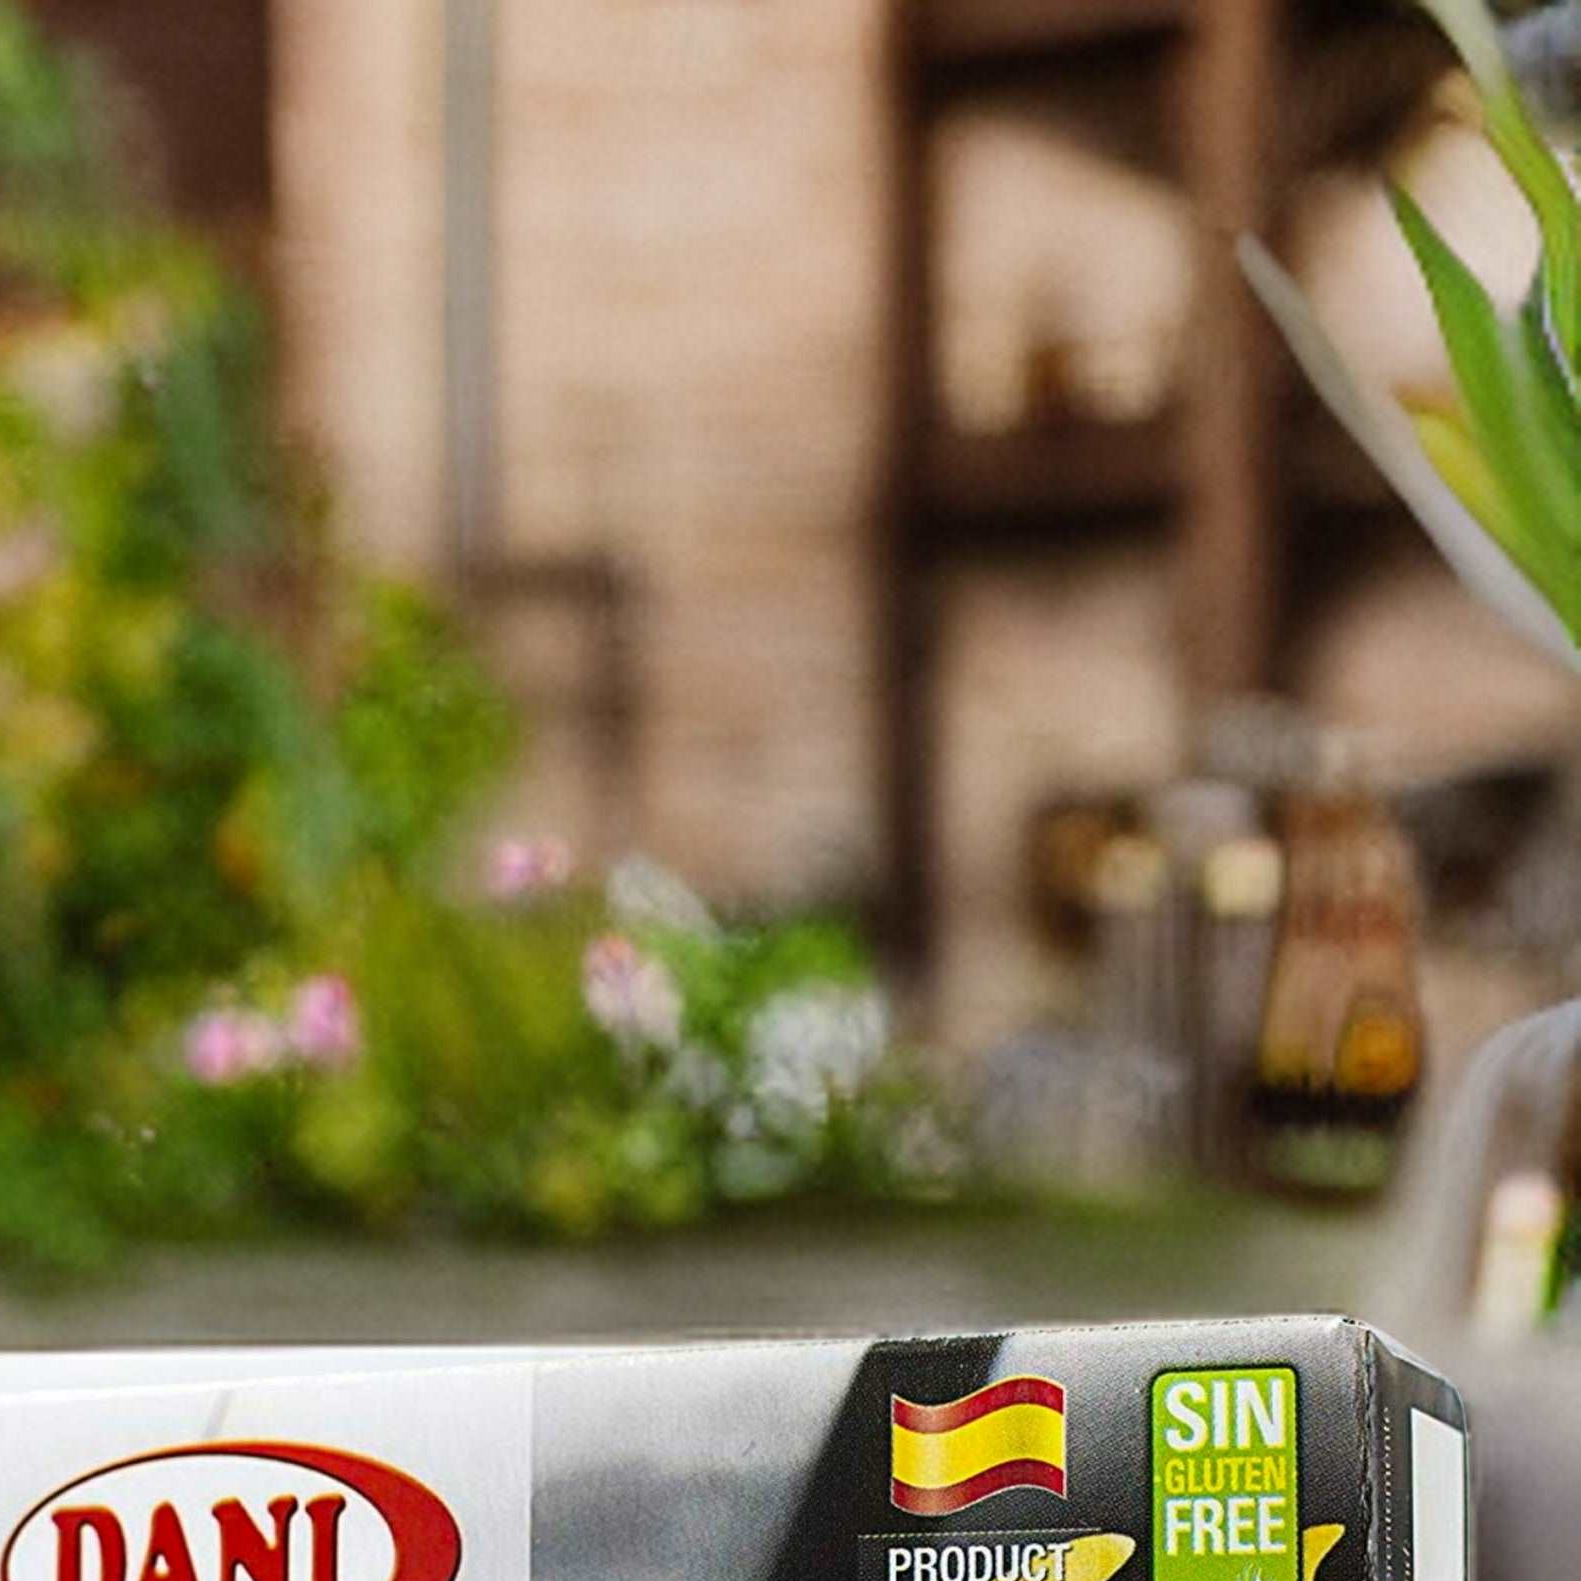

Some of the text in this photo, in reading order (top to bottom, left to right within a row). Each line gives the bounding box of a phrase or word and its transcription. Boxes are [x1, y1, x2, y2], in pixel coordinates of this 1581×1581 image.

[1164, 1380, 1285, 1452] SIN
[1164, 1456, 1286, 1494] GLUTEN
[1164, 1497, 1287, 1556] FREE
